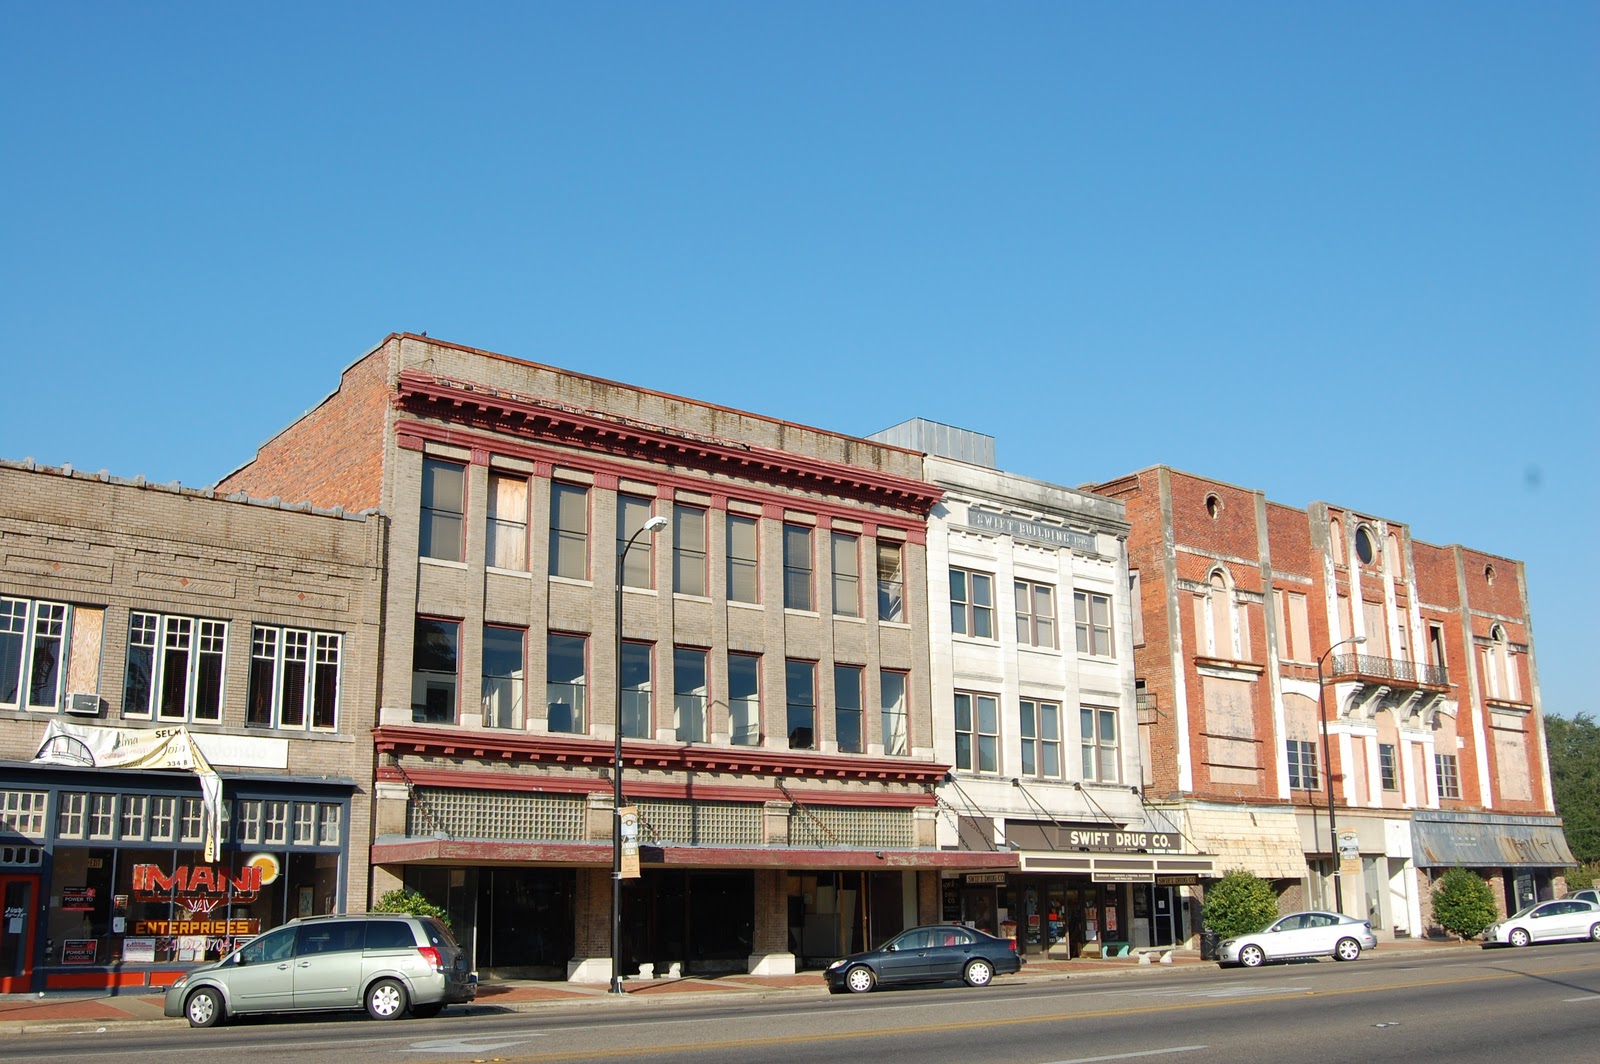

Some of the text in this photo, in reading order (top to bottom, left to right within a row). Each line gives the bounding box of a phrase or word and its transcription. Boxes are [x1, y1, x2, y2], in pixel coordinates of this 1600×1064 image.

[977, 513, 1014, 531] SWIFT
[1019, 523, 1070, 543] BUILDING
[155, 728, 186, 739] SELM
[1070, 831, 1171, 848] SWIFT DRUG CO.
[132, 864, 262, 892] IMANI
[135, 921, 249, 934] ENTERPRISES
